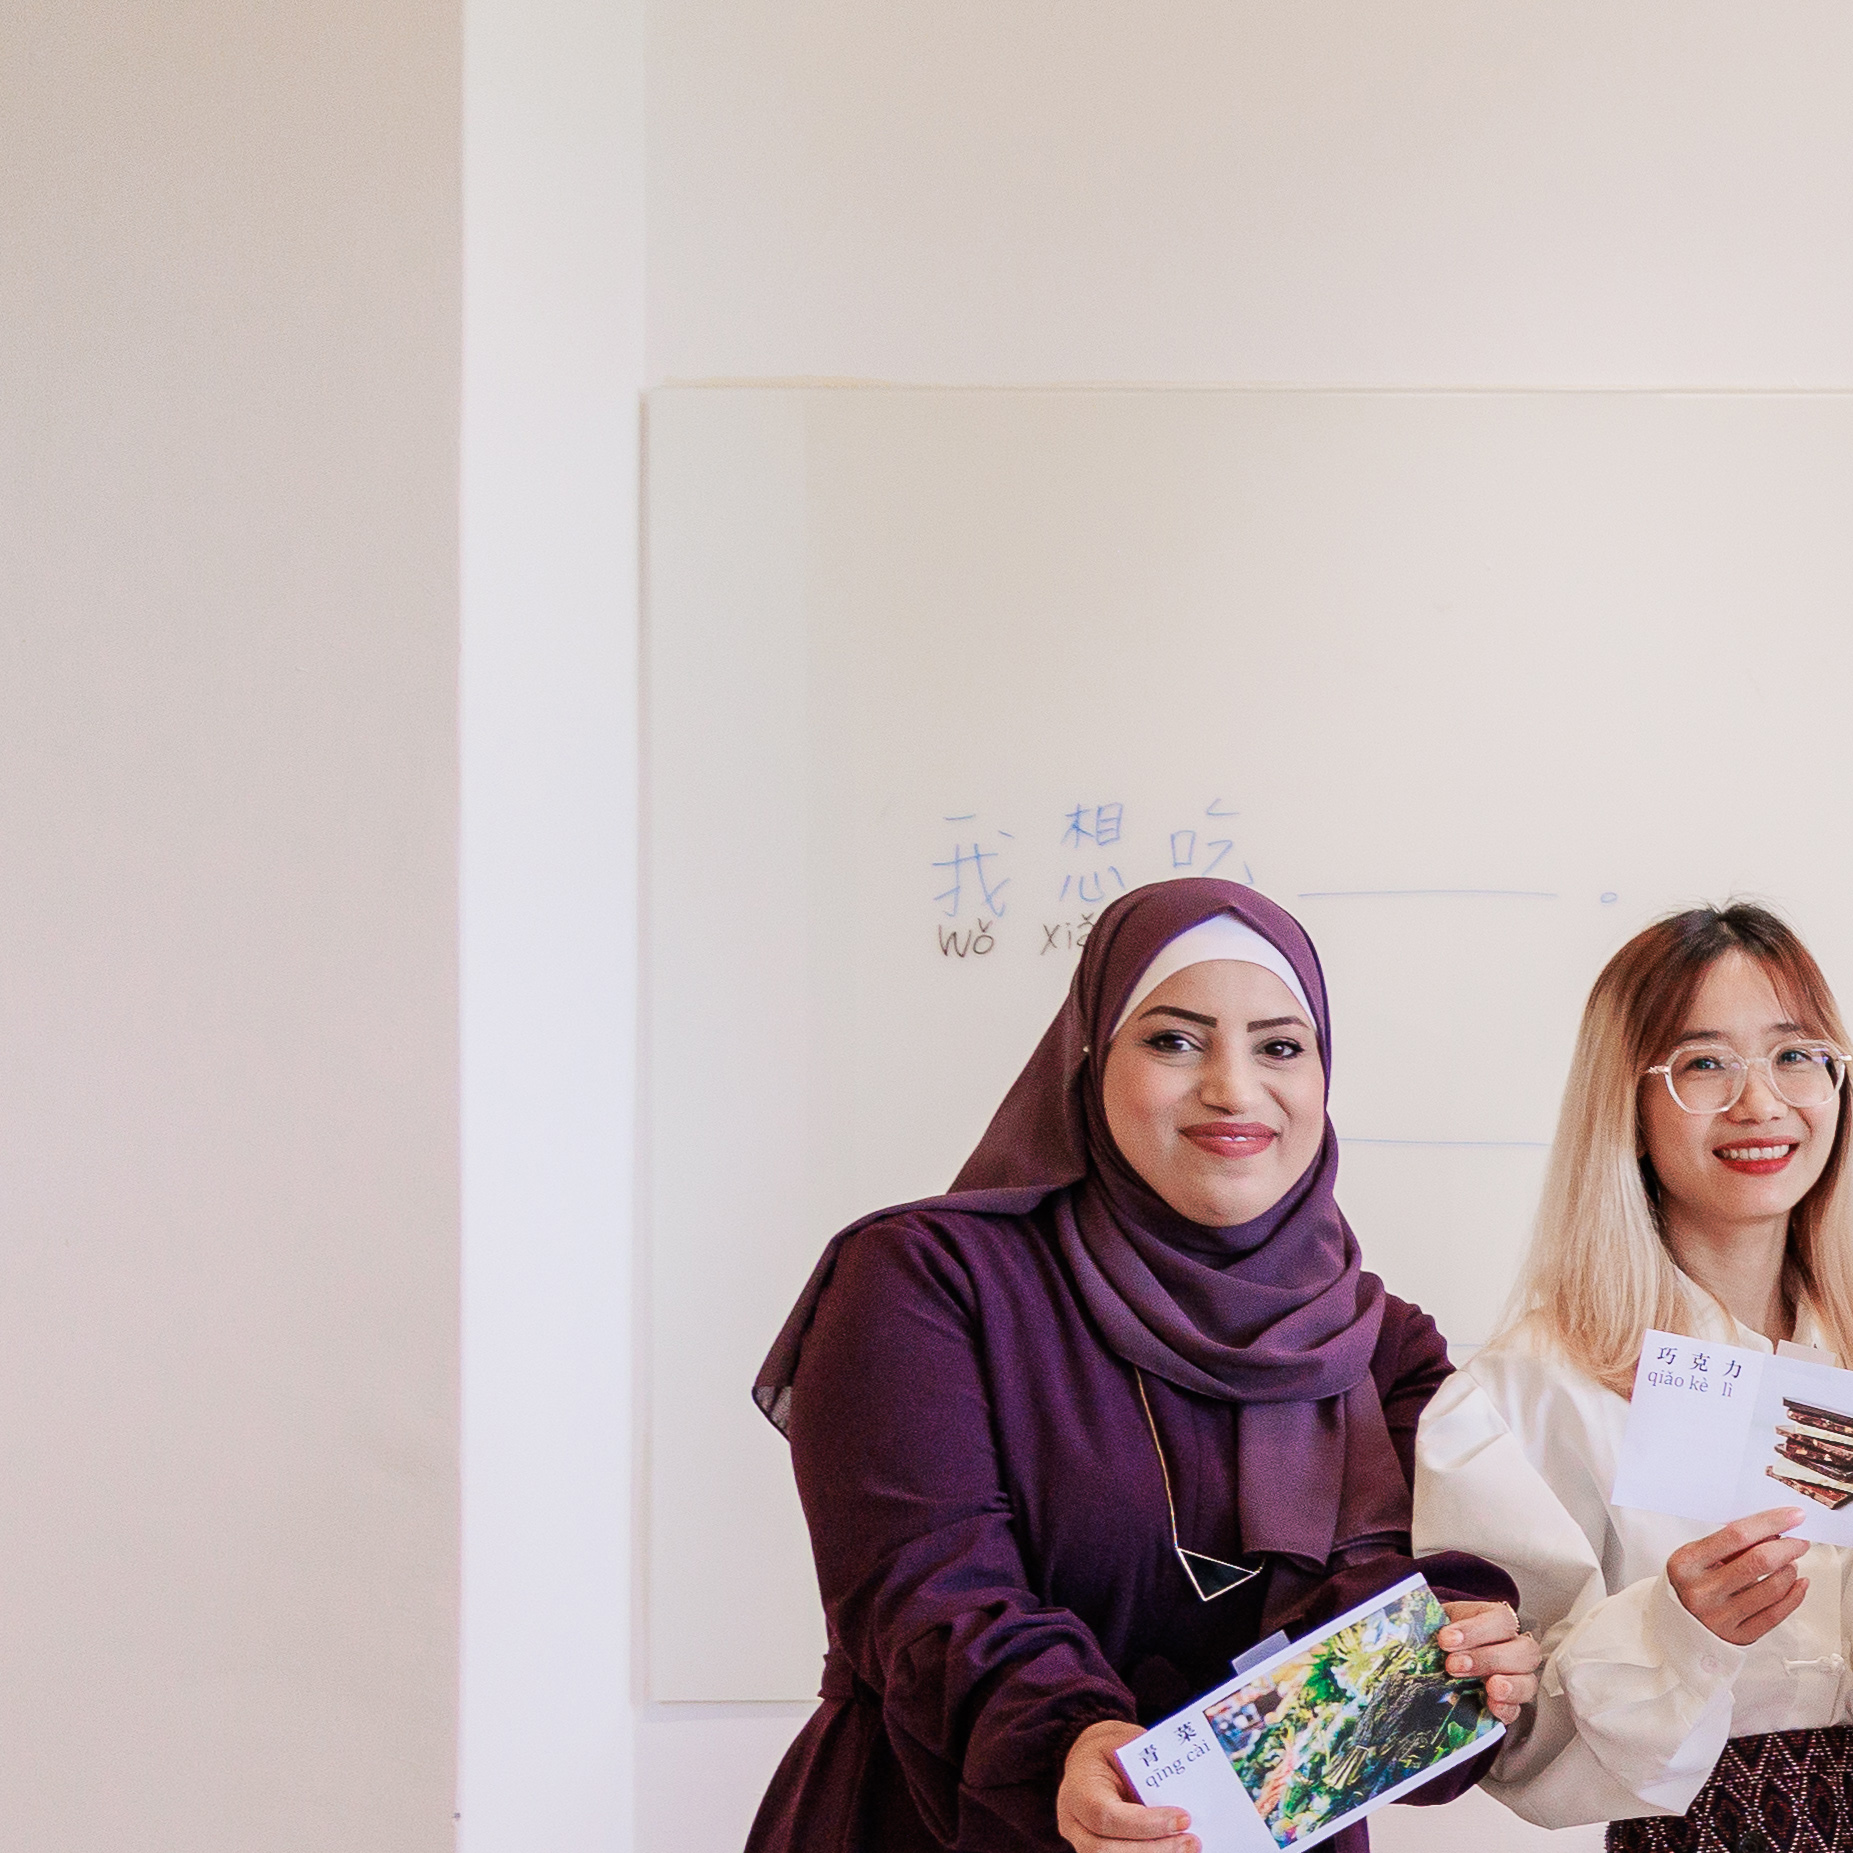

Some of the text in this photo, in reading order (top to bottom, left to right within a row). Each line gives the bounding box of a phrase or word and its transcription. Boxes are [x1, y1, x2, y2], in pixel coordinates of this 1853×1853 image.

[1656, 1346, 1742, 1379] 巧克力
[1647, 1369, 1733, 1397] qiǎo kè lì
[1138, 1721, 1197, 1767] 青菜
[1145, 1739, 1211, 1788] qīng cài
